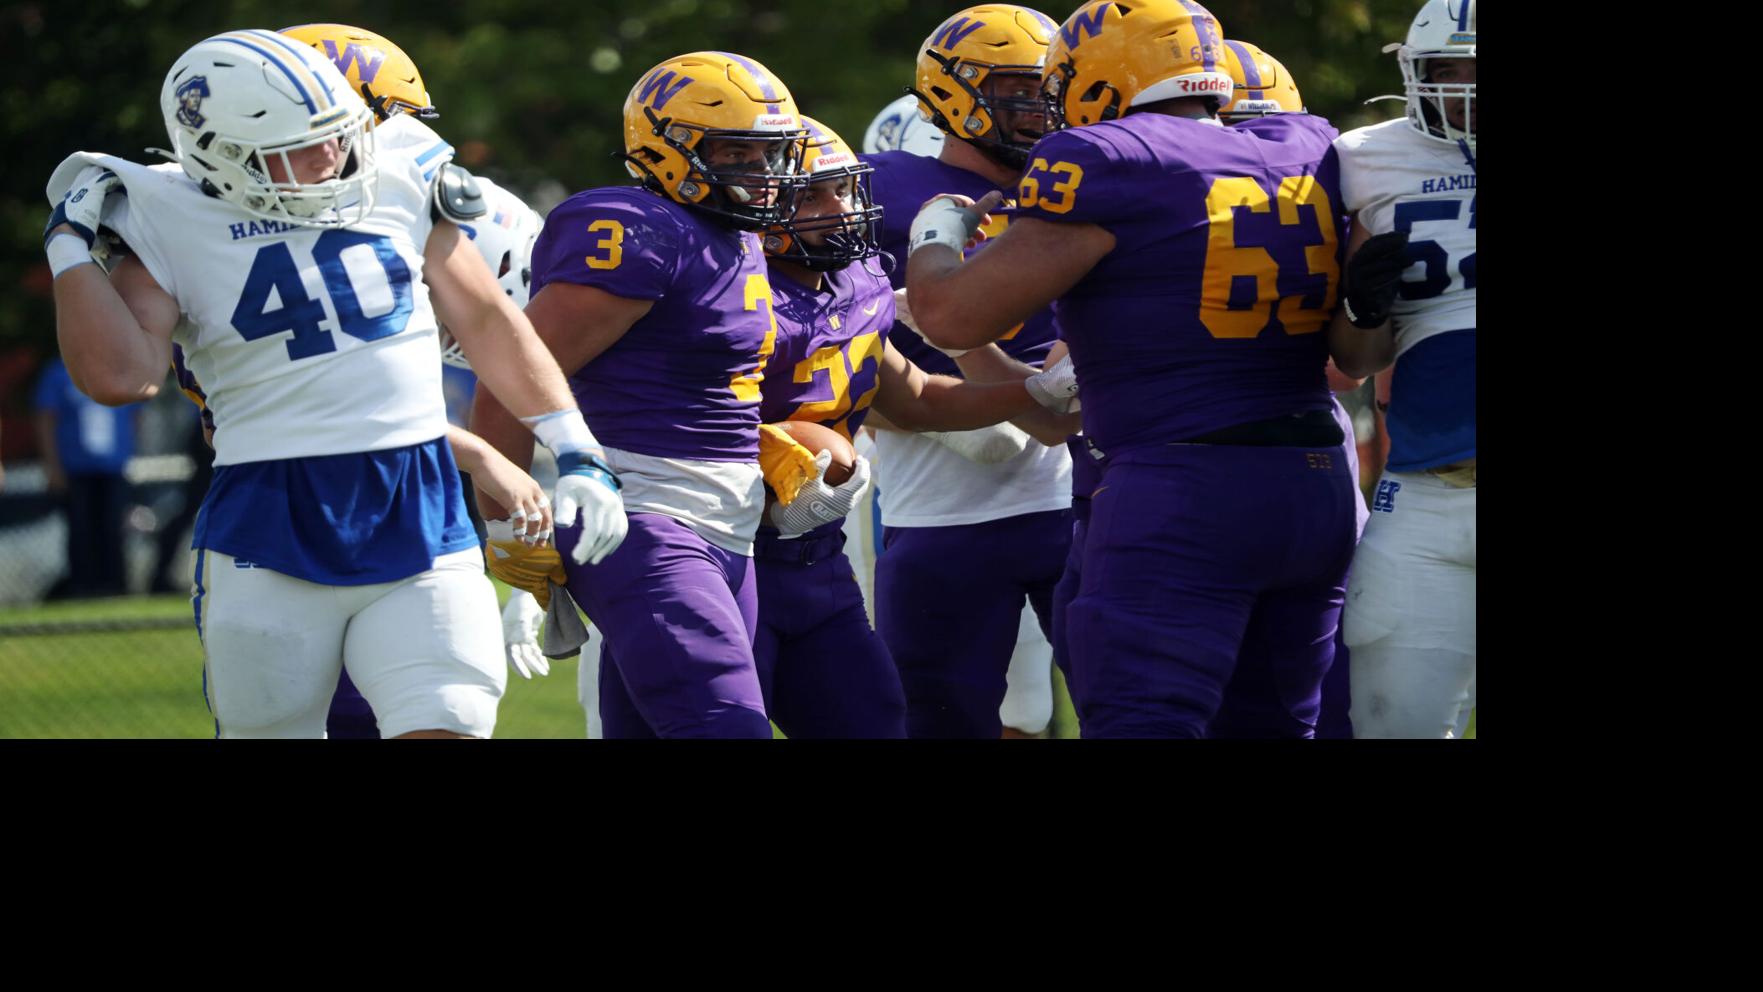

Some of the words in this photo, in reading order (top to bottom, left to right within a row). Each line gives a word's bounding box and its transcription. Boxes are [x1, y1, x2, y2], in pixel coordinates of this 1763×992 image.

[932, 17, 986, 51] W
[321, 40, 386, 84] W
[637, 67, 695, 112] W
[1019, 157, 1084, 214] 63
[585, 219, 625, 271] 3
[1199, 175, 1340, 339] 63
[231, 229, 414, 361] 40
